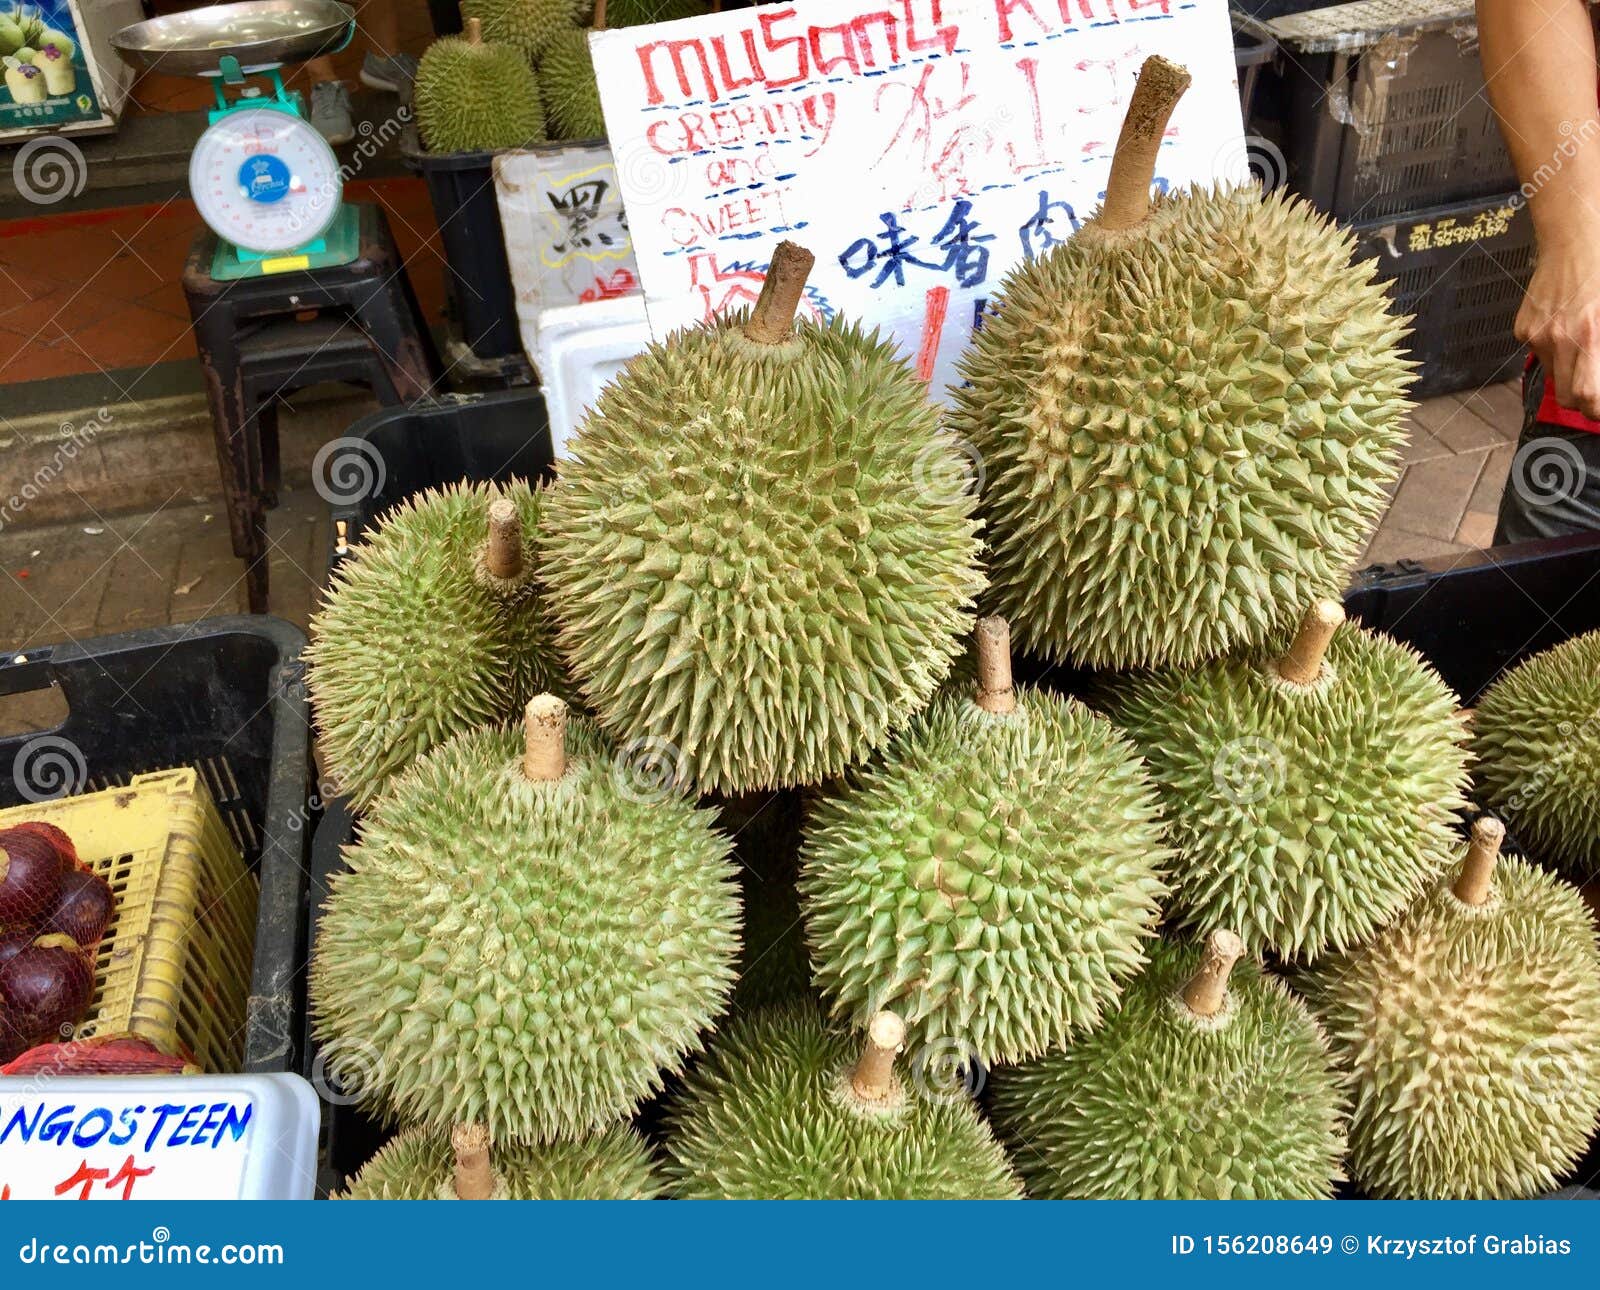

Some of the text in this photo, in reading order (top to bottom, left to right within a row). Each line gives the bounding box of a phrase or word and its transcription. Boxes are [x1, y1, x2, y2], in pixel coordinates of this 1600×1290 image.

[546, 179, 629, 253] 黑
[838, 177, 1170, 289] 味香肉
[0, 1102, 252, 1152] NGOSTEEN
